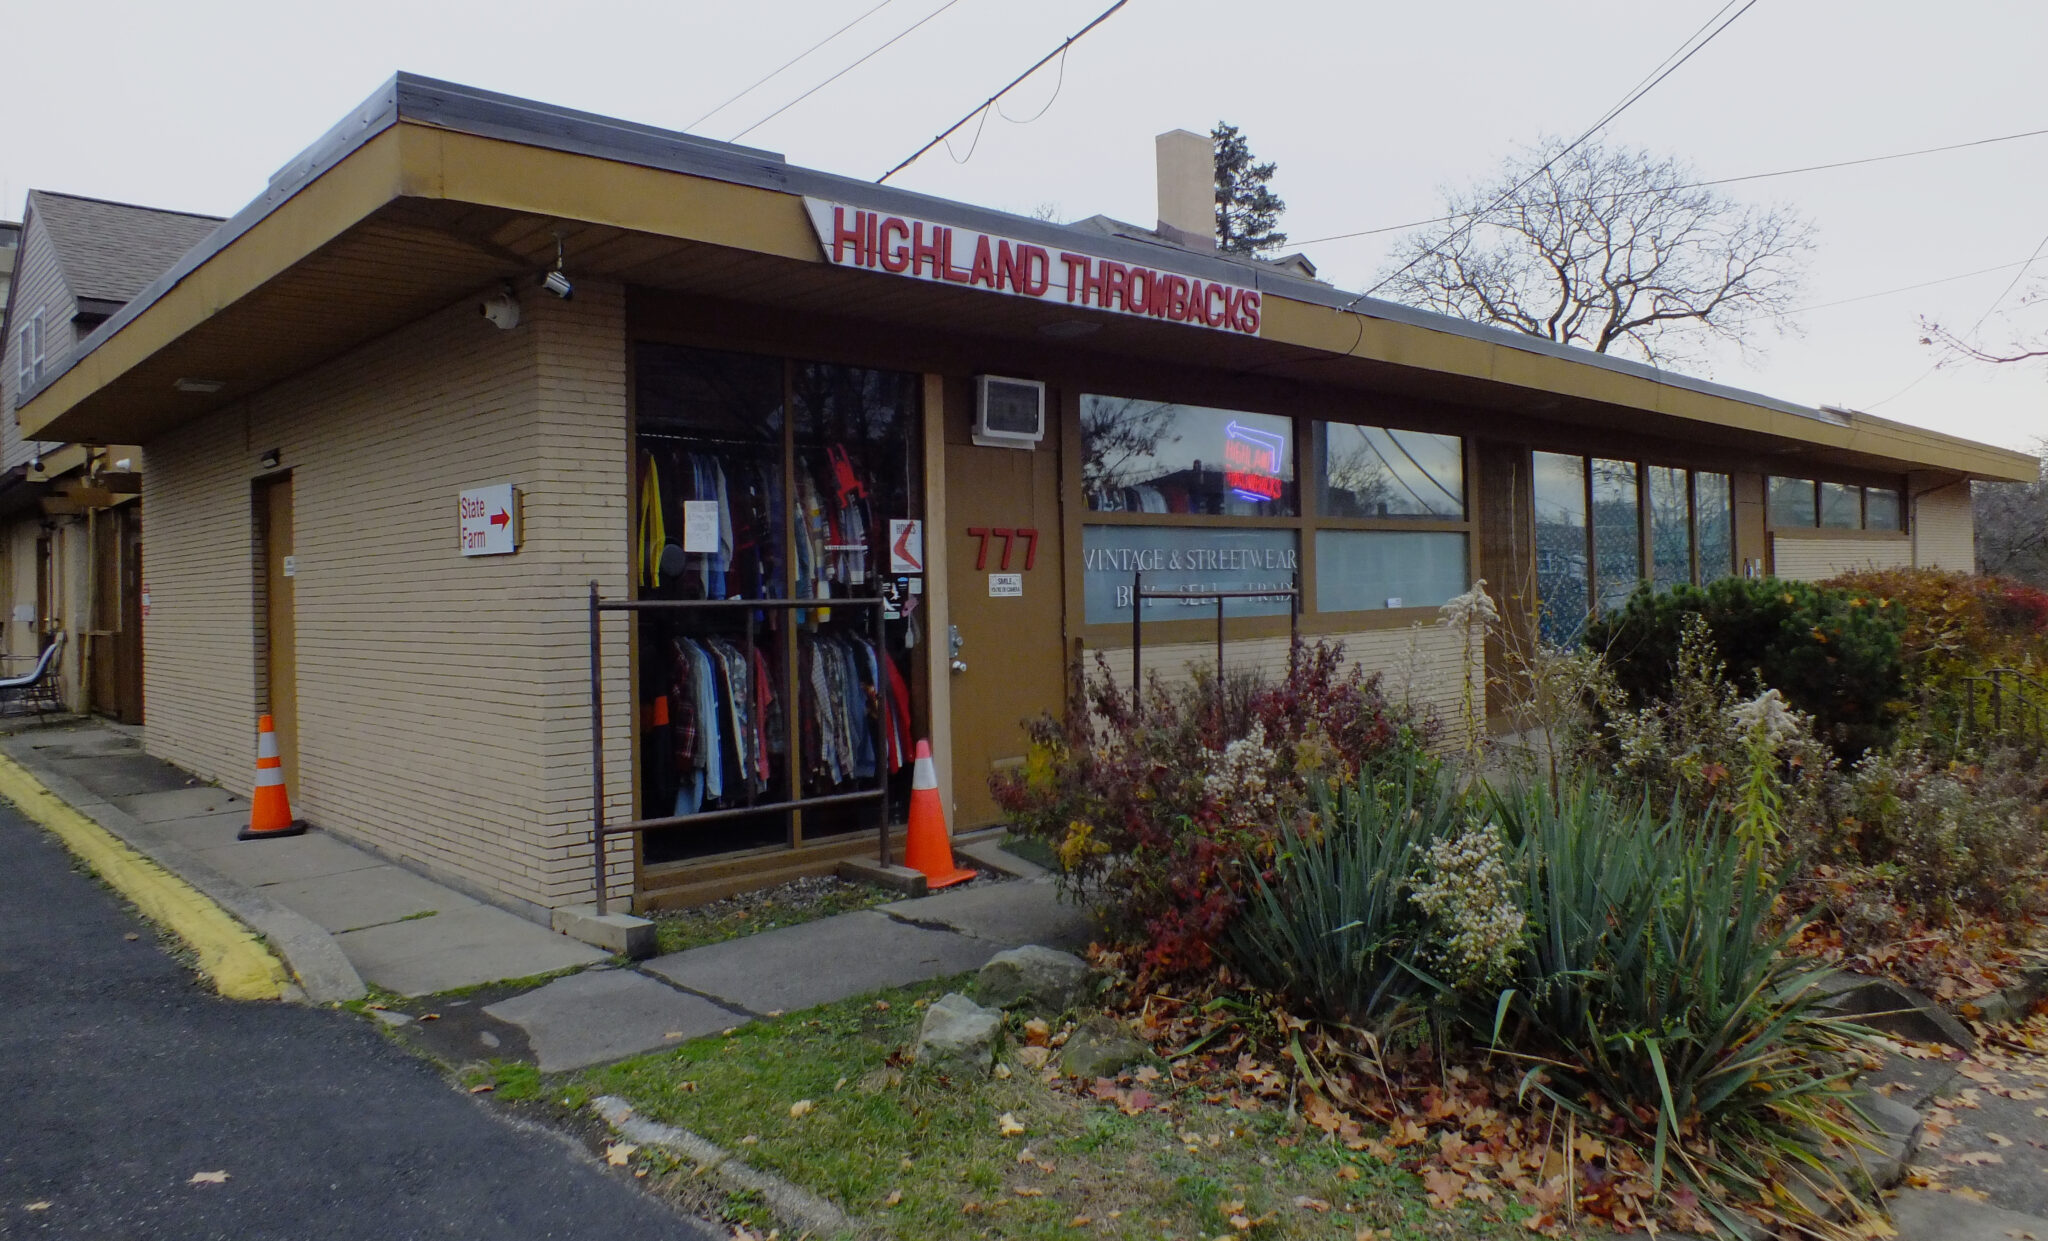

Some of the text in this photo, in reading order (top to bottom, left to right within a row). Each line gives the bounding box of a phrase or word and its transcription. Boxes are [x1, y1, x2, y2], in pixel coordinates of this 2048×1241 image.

[833, 206, 1261, 334] HIGHLAND THROWBACKS
[462, 497, 485, 519] State
[462, 527, 486, 549] Farm
[968, 527, 1038, 570] 777
[1083, 548, 1298, 571] VINTAGE & STREETWEAR
[1249, 581, 1294, 603] TRAD
